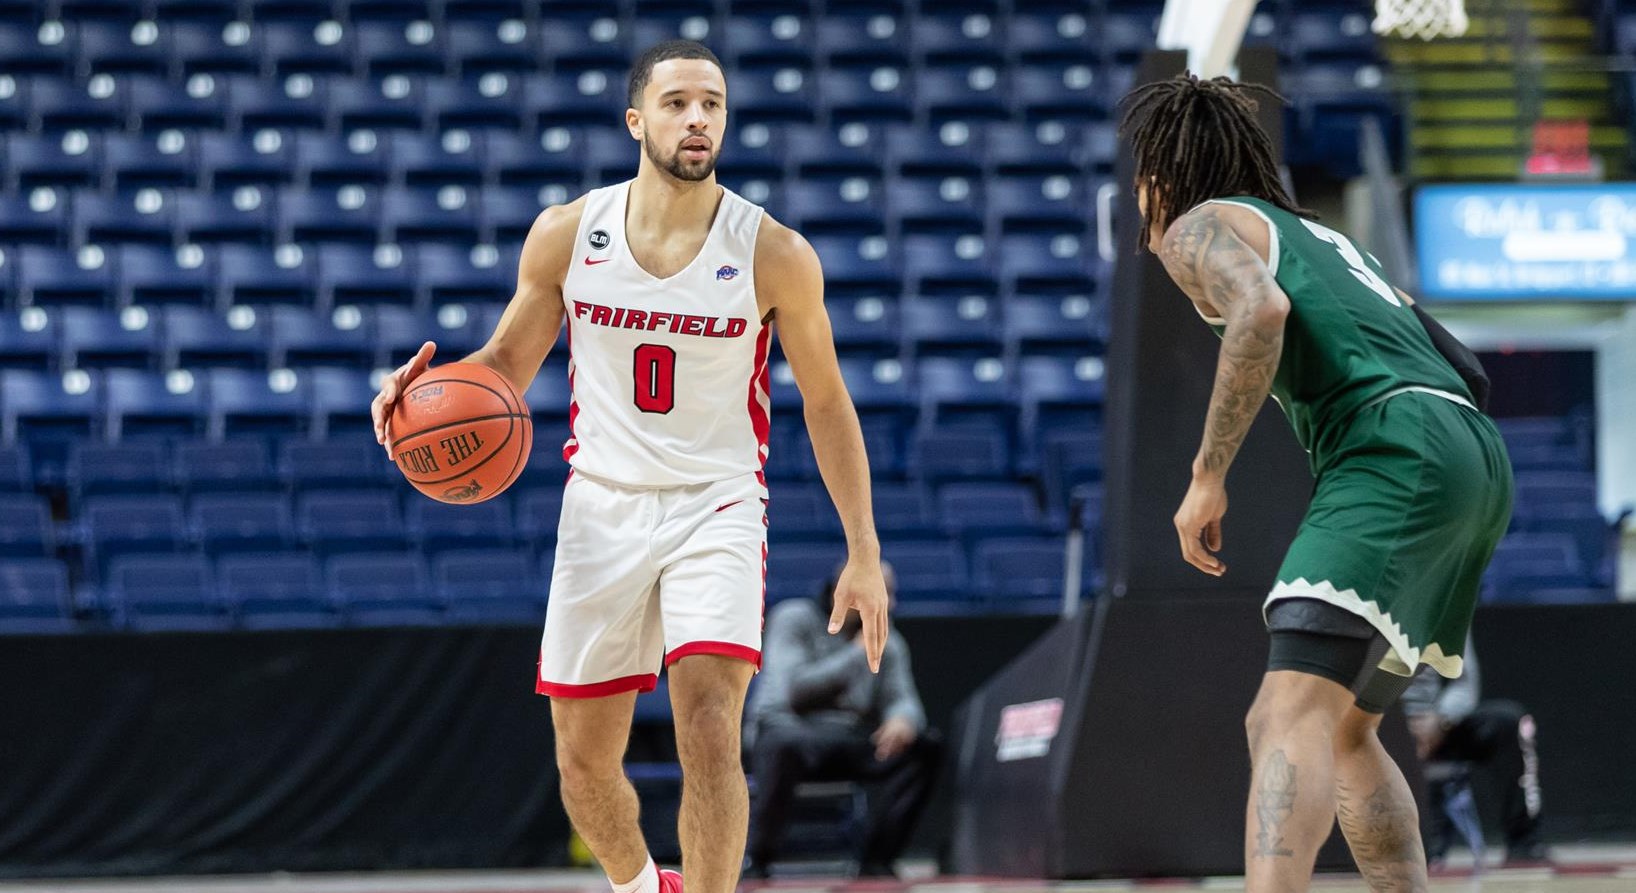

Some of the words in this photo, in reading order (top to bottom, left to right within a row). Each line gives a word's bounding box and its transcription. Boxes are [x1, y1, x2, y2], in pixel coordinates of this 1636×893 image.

[590, 233, 608, 245] BLM
[1299, 217, 1401, 308] 3
[573, 300, 747, 338] FAIRFIELD
[633, 343, 676, 415] 0
[398, 444, 440, 474] ROCK
[440, 431, 484, 466] THE
